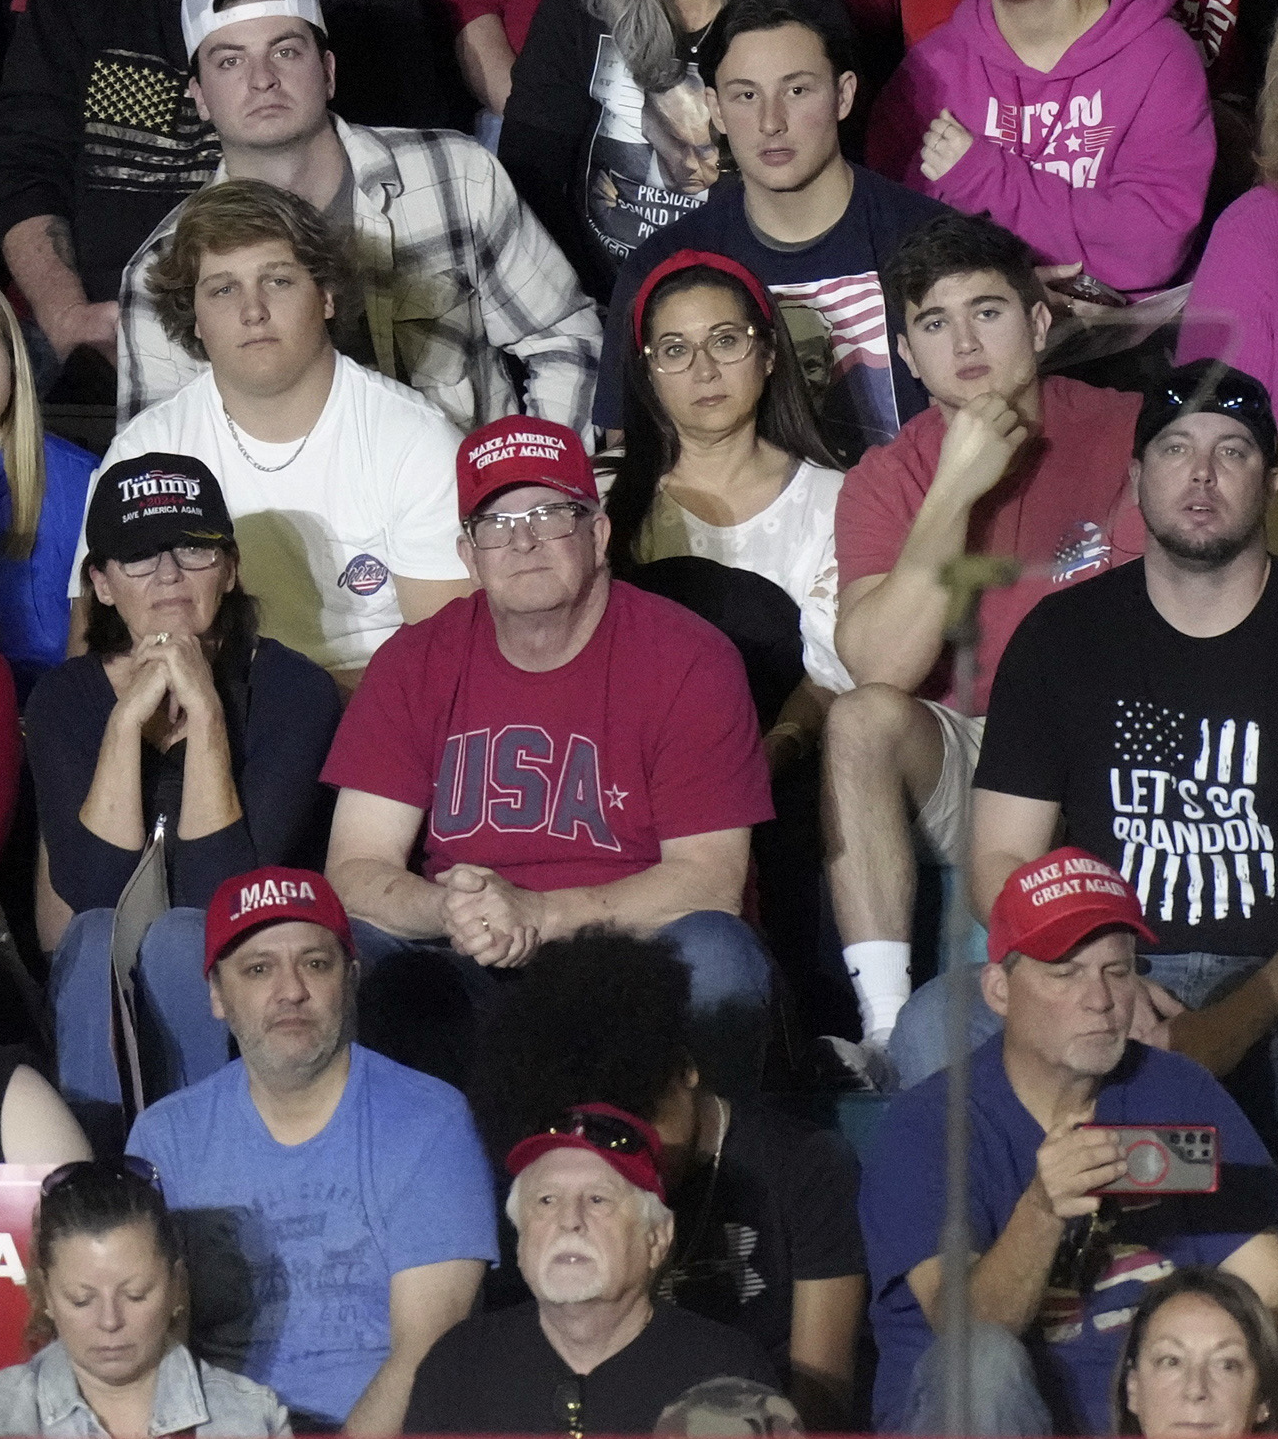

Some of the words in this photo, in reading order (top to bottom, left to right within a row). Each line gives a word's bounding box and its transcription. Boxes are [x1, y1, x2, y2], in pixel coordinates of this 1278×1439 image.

[468, 436, 503, 464] MAKE
[506, 432, 567, 451] AMERICA
[476, 445, 516, 470] GREAT
[518, 445, 559, 462] AGAIN
[117, 477, 201, 502] Trump
[121, 509, 140, 523] SAVE
[142, 504, 179, 518] AMERICA
[180, 504, 204, 517] AGAIN
[432, 724, 621, 852] USA
[1110, 767, 1205, 819] LET'S
[1205, 785, 1260, 822] GO
[1112, 815, 1275, 855] BRANDON
[240, 879, 317, 904] MAGA
[1020, 862, 1063, 893] MAKE
[240, 895, 288, 915] KING
[1031, 878, 1081, 907] GREAT
[1084, 878, 1128, 898] AGAIN
